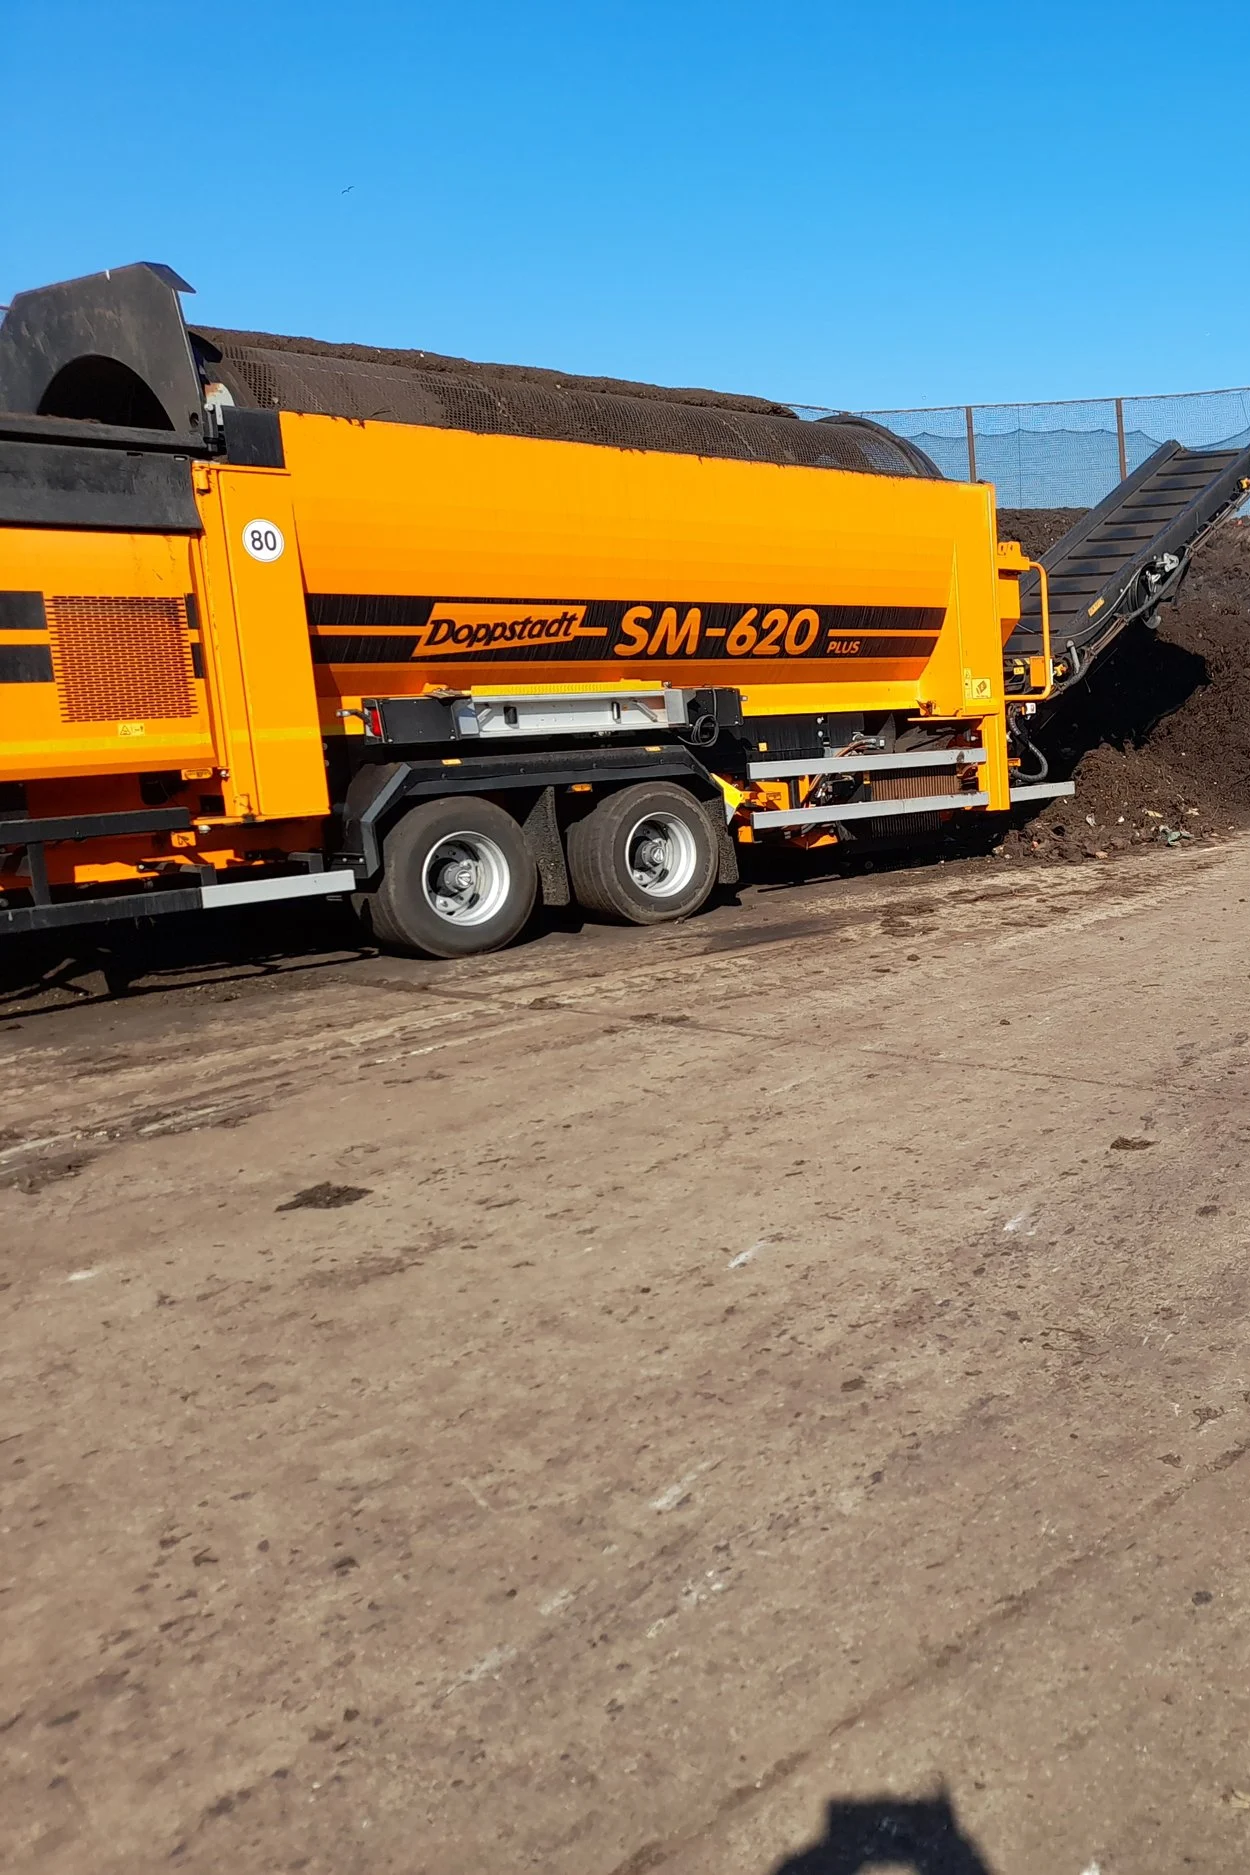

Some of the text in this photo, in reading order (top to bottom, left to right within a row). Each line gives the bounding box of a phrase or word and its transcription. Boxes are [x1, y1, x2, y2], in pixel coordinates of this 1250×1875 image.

[251, 530, 277, 551] 80
[424, 611, 578, 649] Doppstadt
[613, 605, 861, 657] SM-620 PLUS
